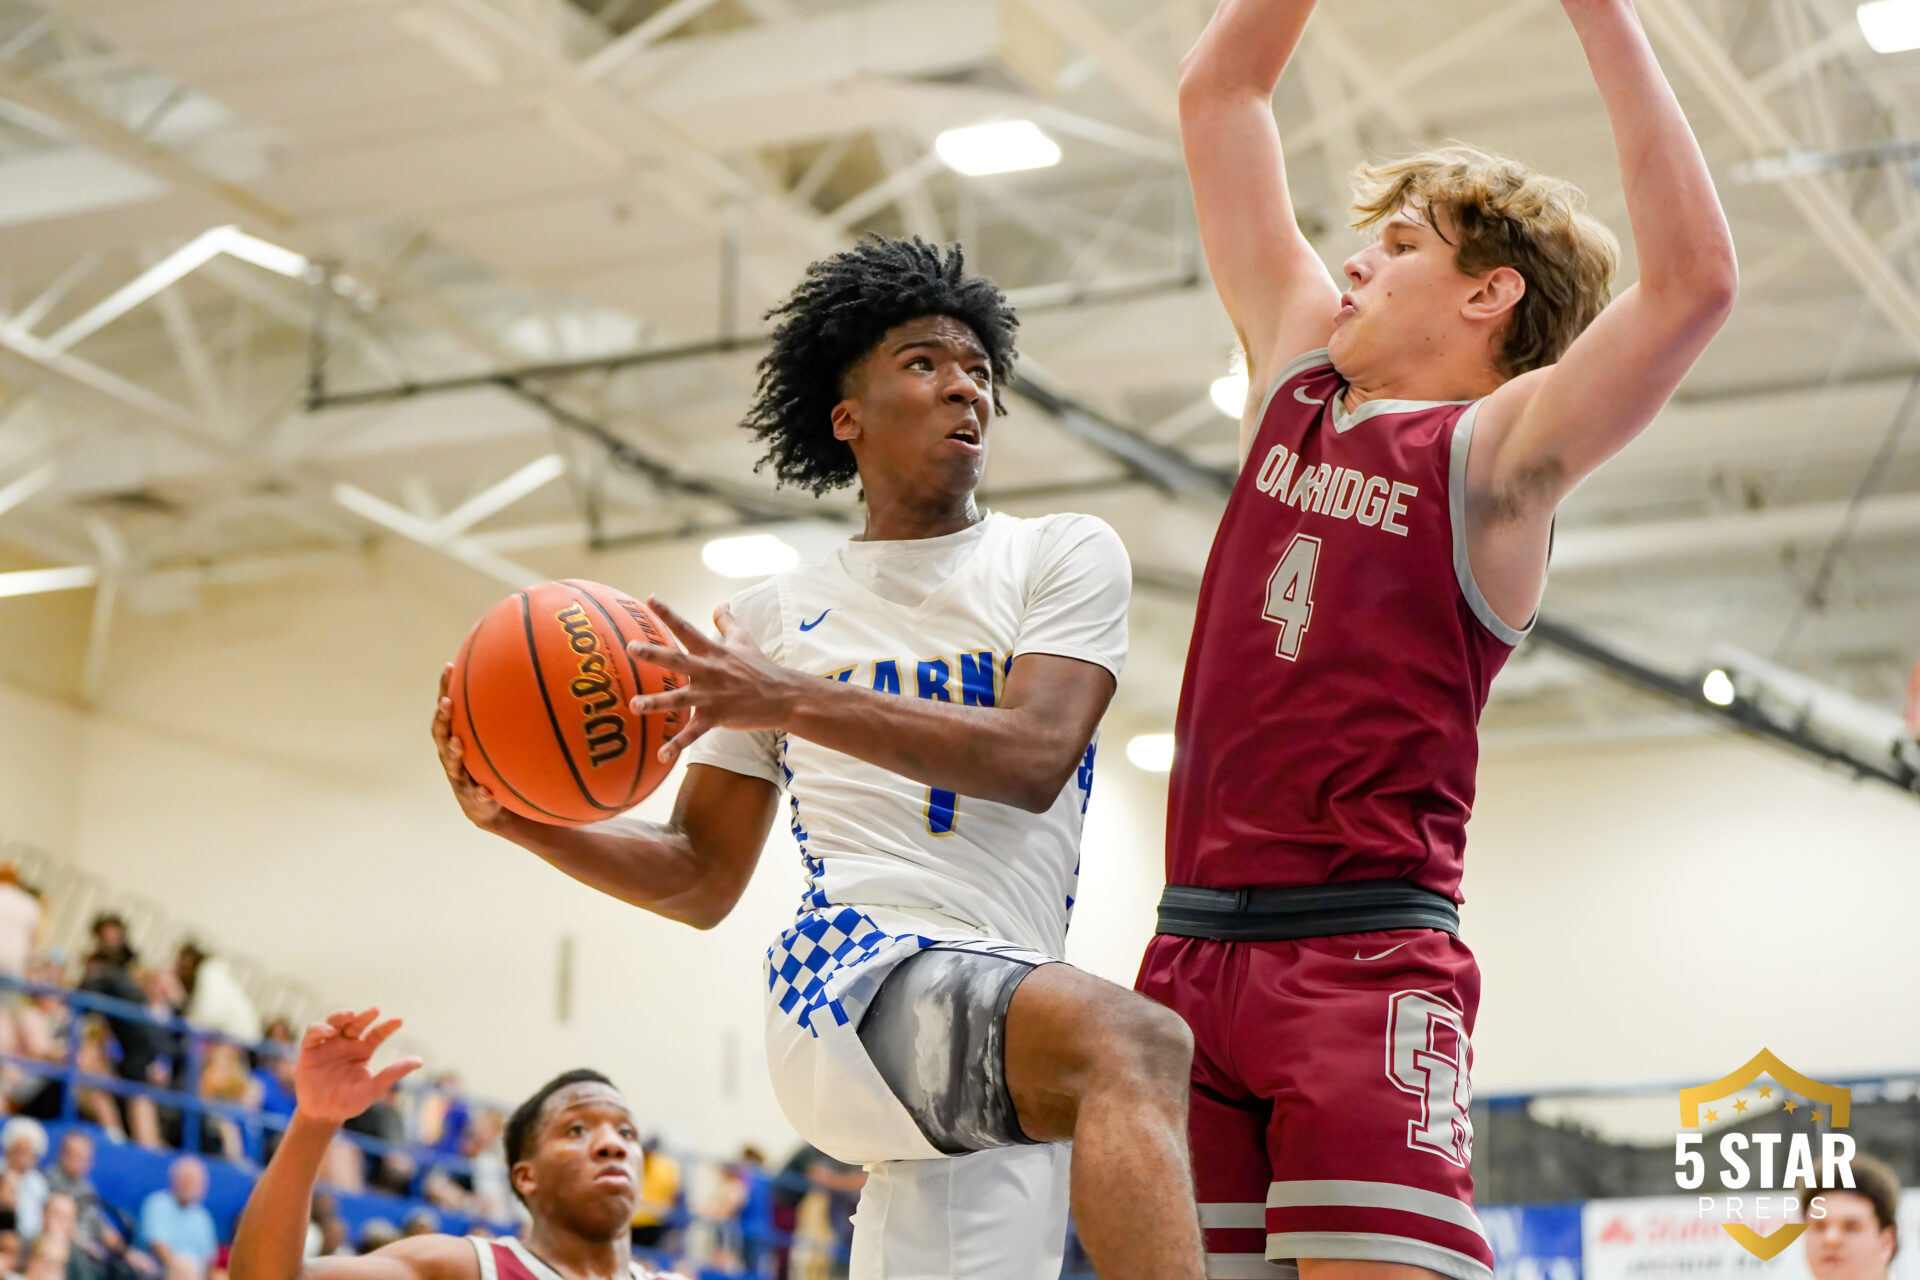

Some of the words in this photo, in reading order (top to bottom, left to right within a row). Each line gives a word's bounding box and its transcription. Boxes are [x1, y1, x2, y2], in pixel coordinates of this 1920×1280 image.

[1261, 532, 1322, 662] 4
[554, 600, 630, 769] Wilson
[821, 648, 1014, 707] ARN
